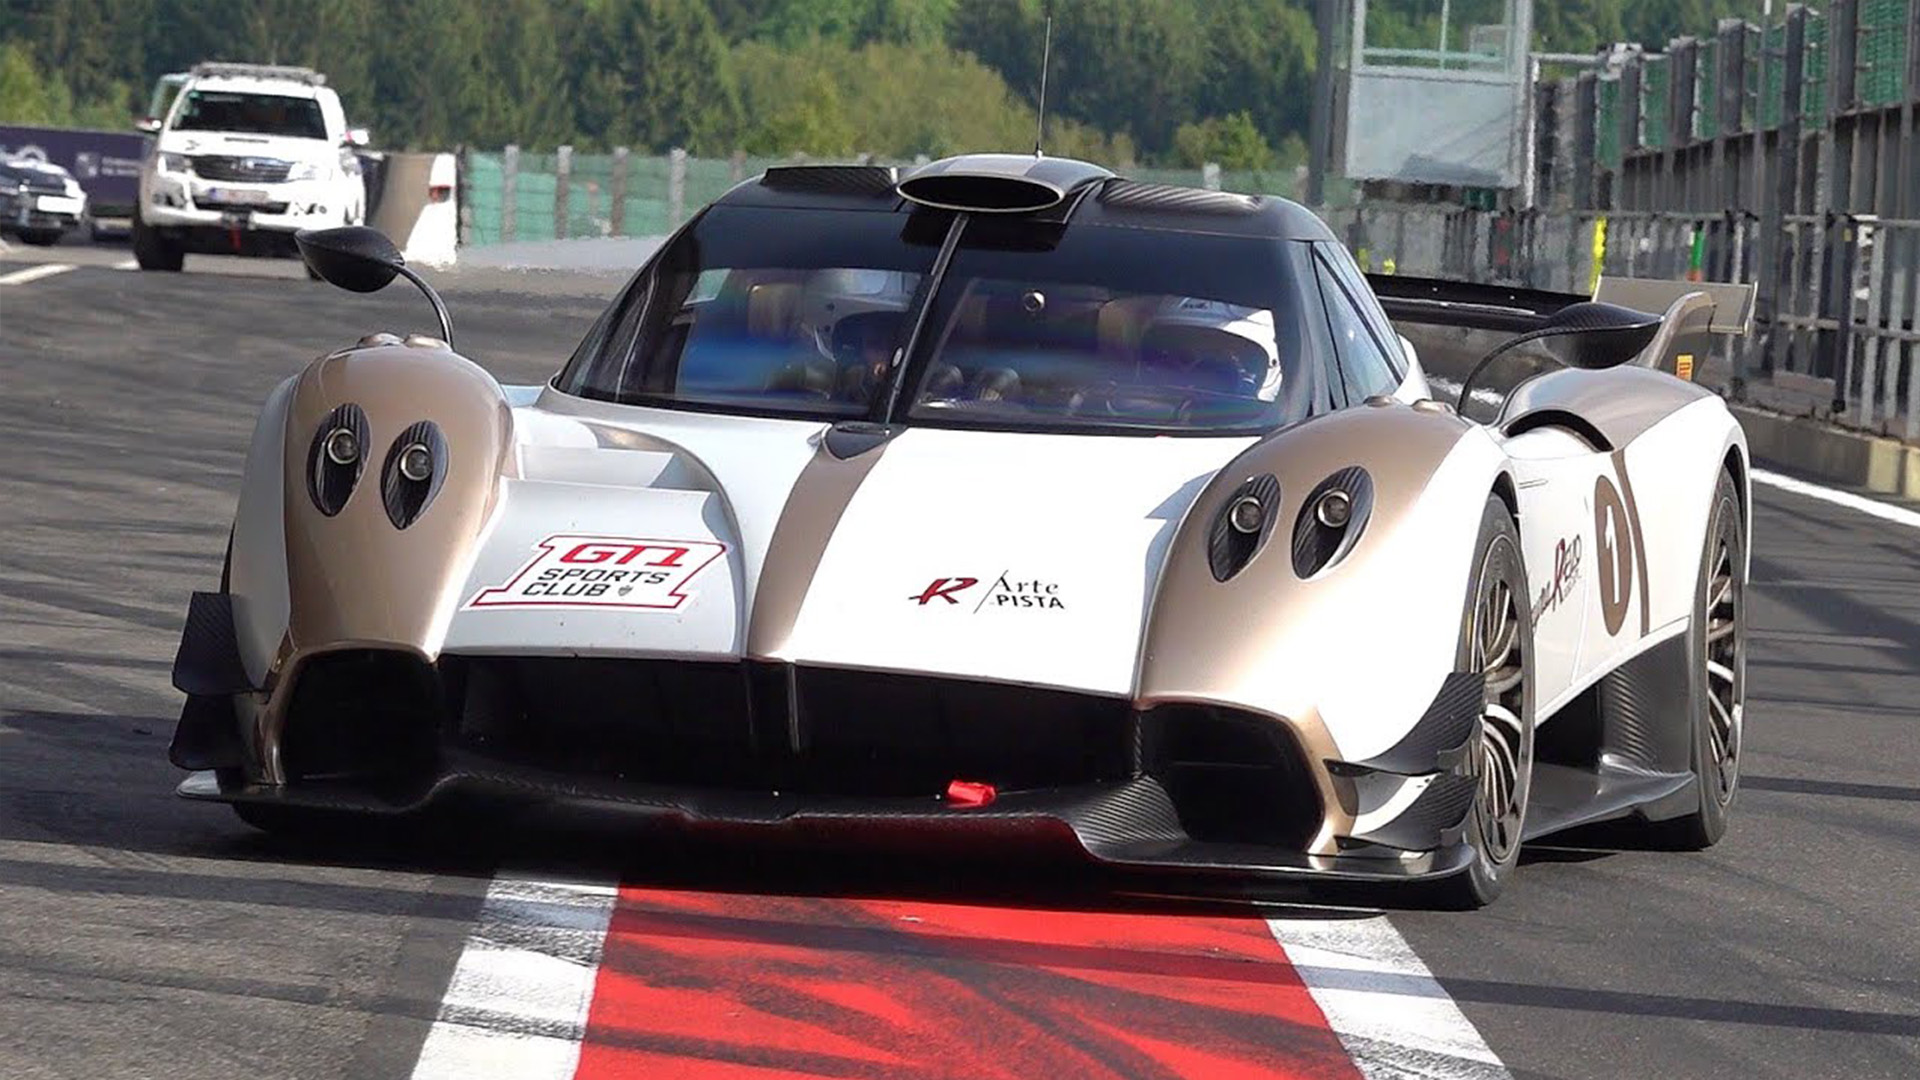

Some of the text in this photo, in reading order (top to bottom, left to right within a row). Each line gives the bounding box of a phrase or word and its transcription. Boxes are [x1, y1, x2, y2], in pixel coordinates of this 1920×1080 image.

[559, 543, 690, 567] GT1
[1604, 504, 1620, 604] 1
[538, 568, 670, 584] SPORTS
[522, 582, 611, 597] CLUB
[996, 594, 1065, 609] PISTA
